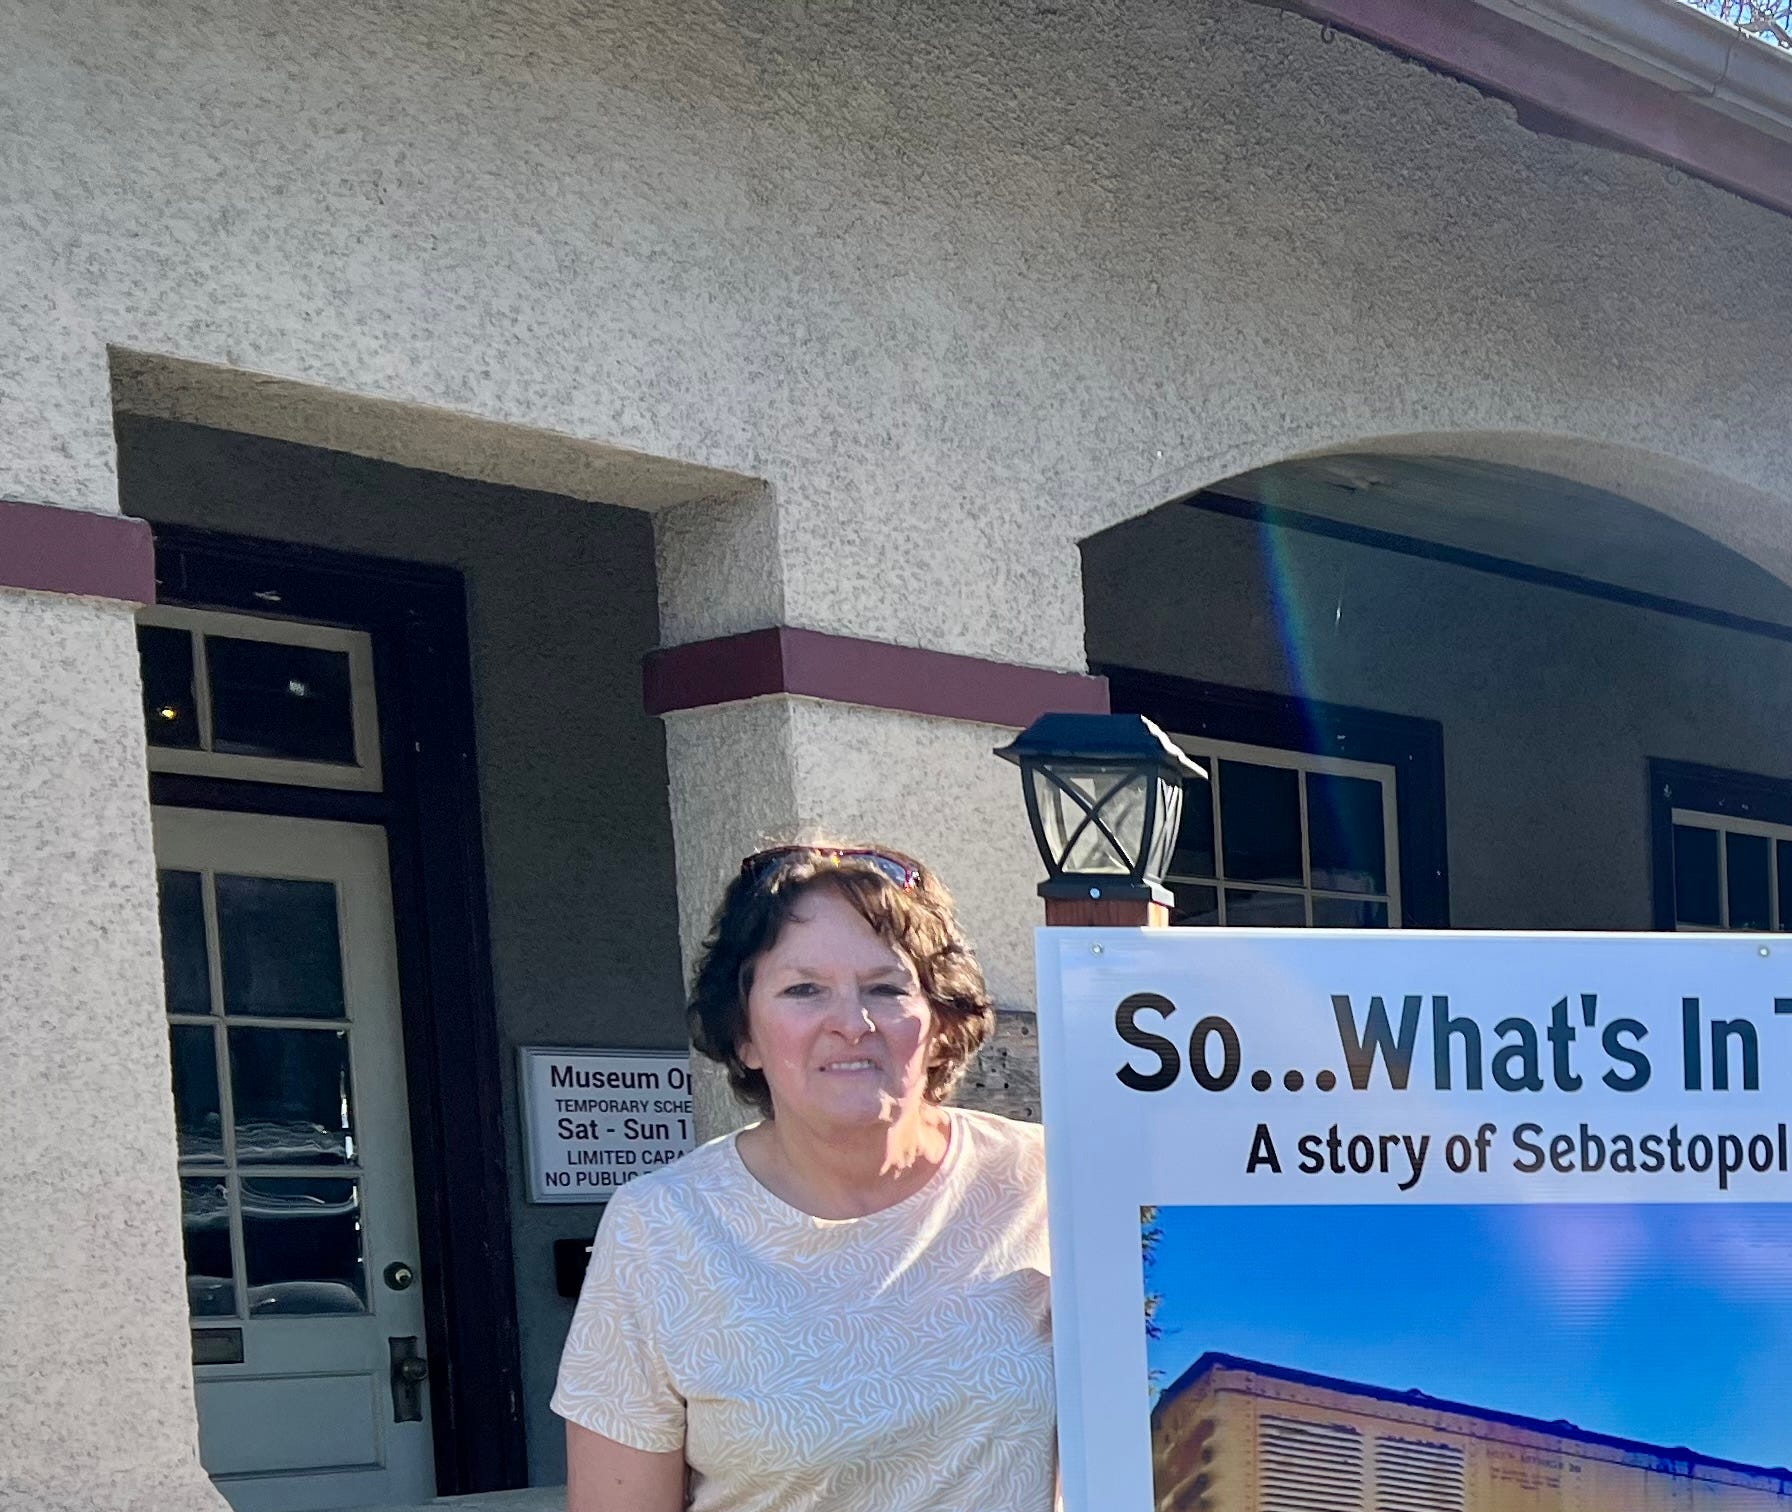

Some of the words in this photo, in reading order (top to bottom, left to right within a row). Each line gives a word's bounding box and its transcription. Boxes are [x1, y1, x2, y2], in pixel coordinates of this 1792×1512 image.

[1115, 993, 1651, 1092] So...What's
[1682, 997, 1759, 1092] In
[551, 1065, 659, 1090] Museum
[555, 1098, 649, 1113] TEMPORARY
[557, 1117, 600, 1140] Sat
[623, 1118, 669, 1140] Sun
[567, 1150, 637, 1166] LIMITED
[1246, 1124, 1282, 1174] A
[1298, 1123, 1430, 1192] story
[1446, 1122, 1497, 1174] of
[1513, 1122, 1788, 1191] Sebastopol
[545, 1171, 571, 1187] NO
